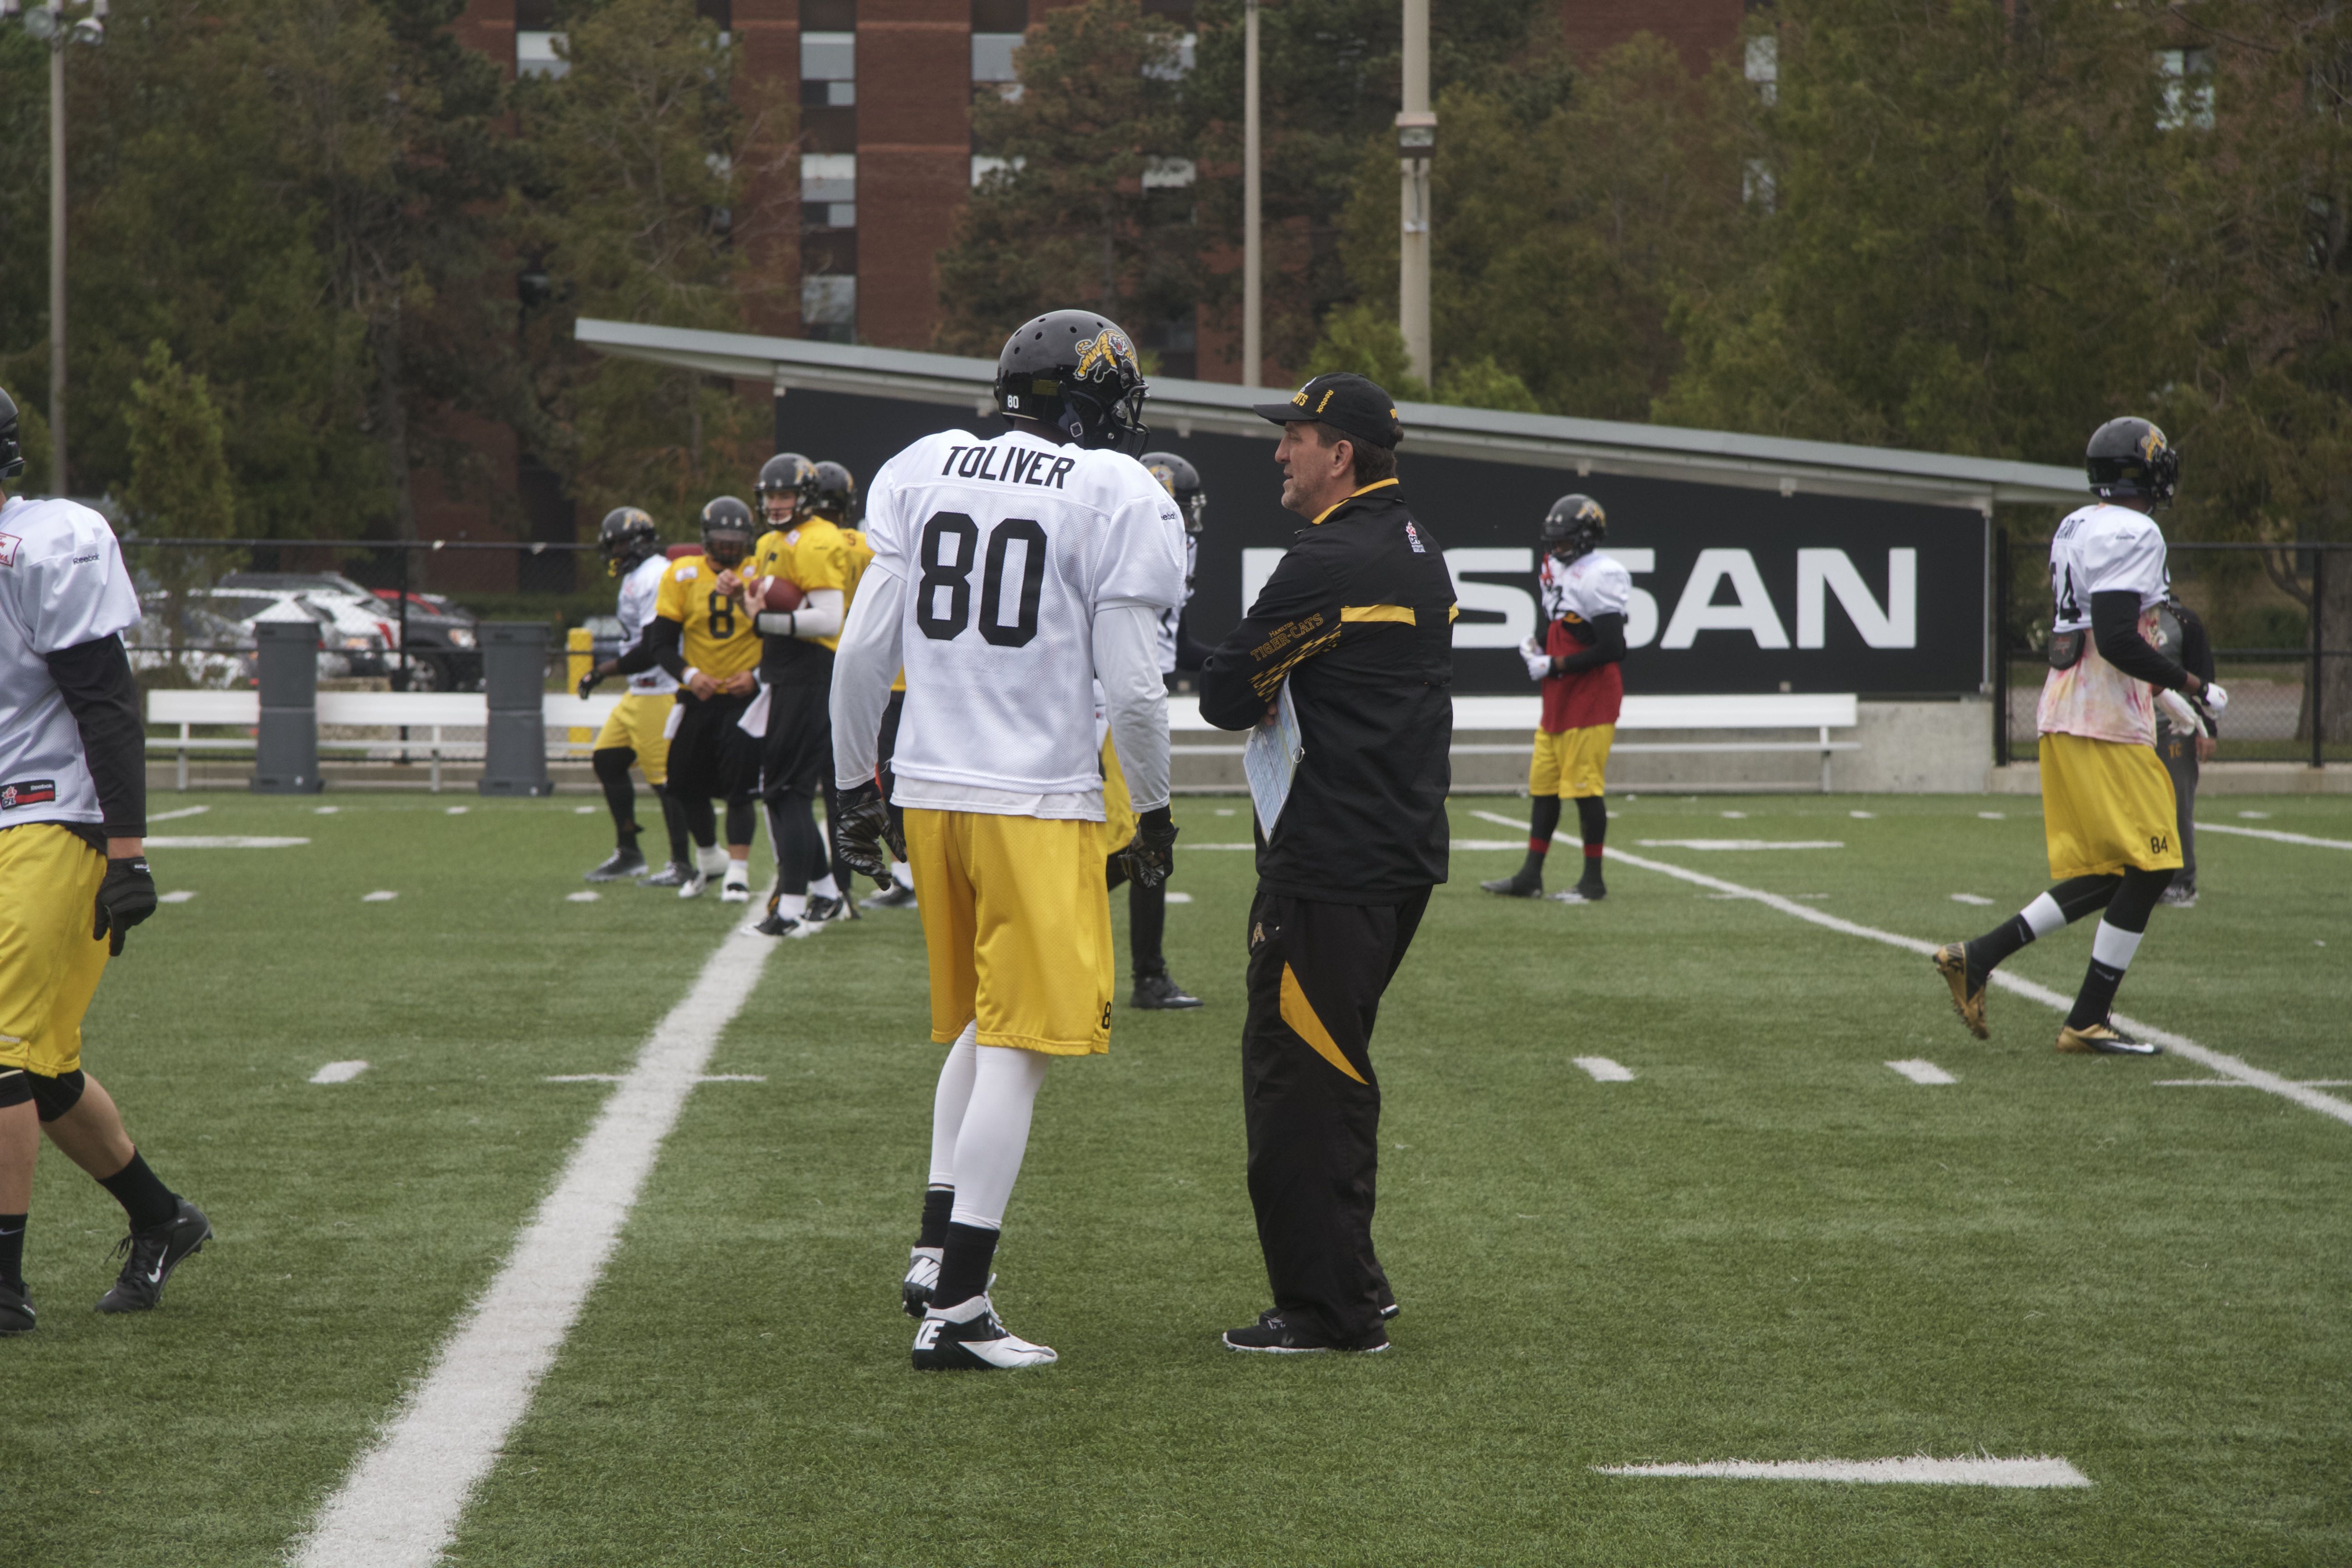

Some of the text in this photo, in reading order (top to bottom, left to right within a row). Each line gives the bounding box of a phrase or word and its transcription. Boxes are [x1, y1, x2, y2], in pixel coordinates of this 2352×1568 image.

[1008, 395, 1019, 409] 80
[1316, 390, 1334, 413] Reebok
[941, 446, 1075, 489] TOLIVER
[73, 553, 100, 565] Reebok
[917, 511, 1047, 648] 80
[709, 589, 734, 639] 8
[1241, 547, 1916, 649] SAN
[1250, 613, 1323, 661] TIGER-CATS
[1269, 621, 1295, 638] HAMILTON
[2150, 834, 2168, 854] 84
